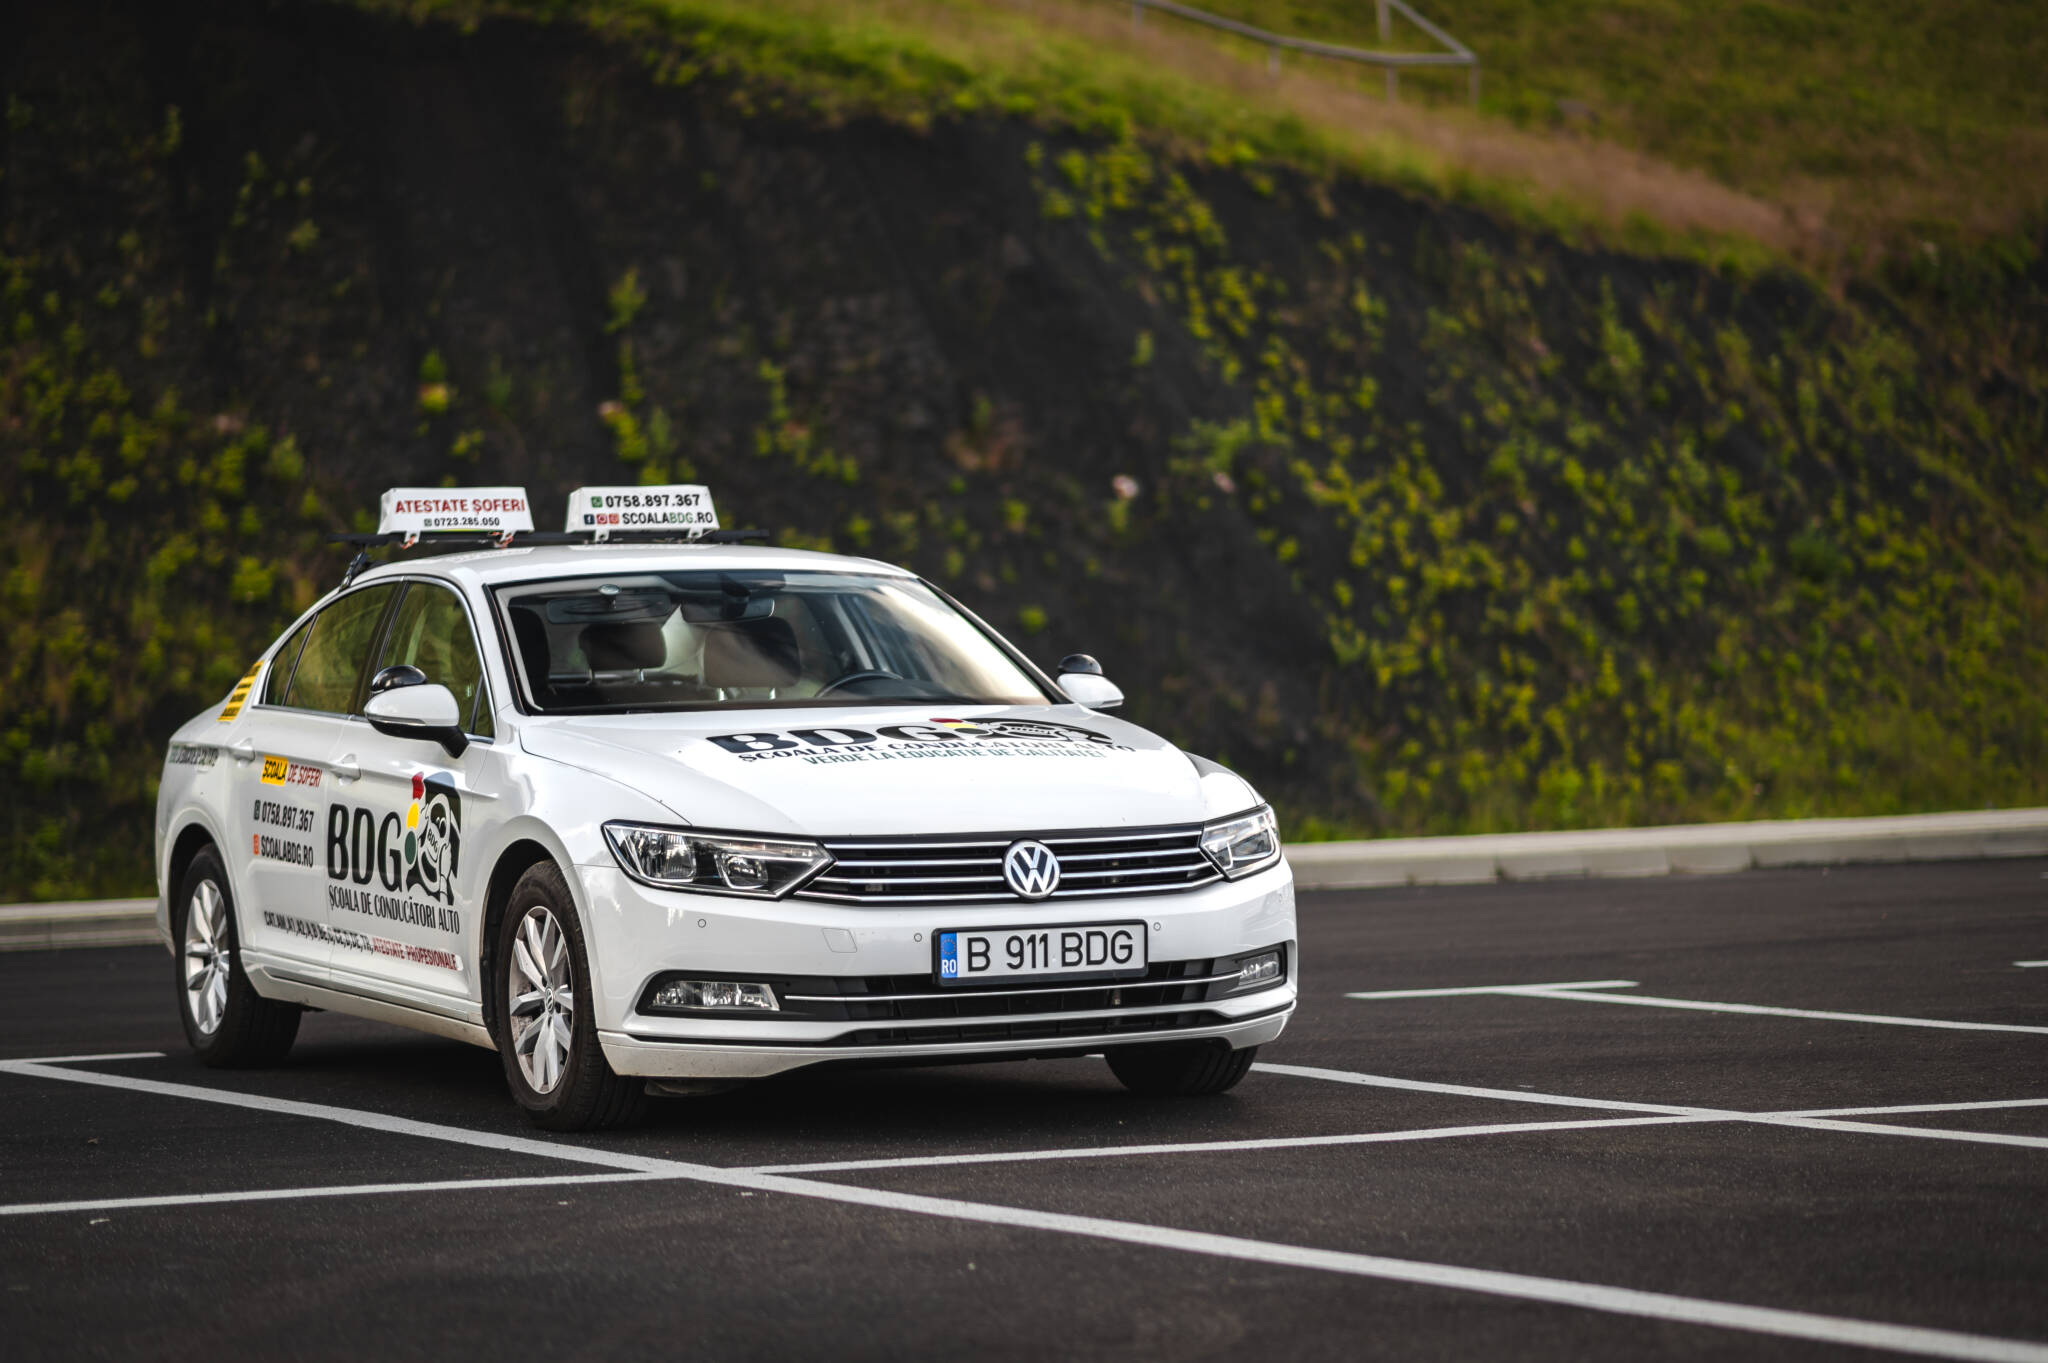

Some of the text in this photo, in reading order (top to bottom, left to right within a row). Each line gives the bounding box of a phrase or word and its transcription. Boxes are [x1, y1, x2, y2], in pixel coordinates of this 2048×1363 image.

[395, 499, 468, 513] ATESTATE
[606, 494, 700, 508] 0758.897.367
[622, 512, 713, 525] SCOALABDG.RO
[705, 725, 965, 753] BDG
[844, 744, 883, 753] DE
[802, 754, 869, 765] VERDE
[869, 752, 895, 761] LA
[986, 748, 1014, 756] DE
[287, 764, 299, 783] DE
[261, 801, 314, 833] 0758.897.367
[261, 835, 314, 868] SCOALABDG.RO
[327, 803, 403, 892] BDG
[427, 828, 438, 853] BDG
[1007, 843, 1059, 896] VW
[329, 884, 360, 911] ȘCOALA
[360, 891, 373, 915] DE
[439, 907, 460, 935] AUTO
[405, 944, 457, 971] PROFESIONALE
[967, 930, 1133, 972] B 911 BDG
[941, 959, 957, 974] RO
